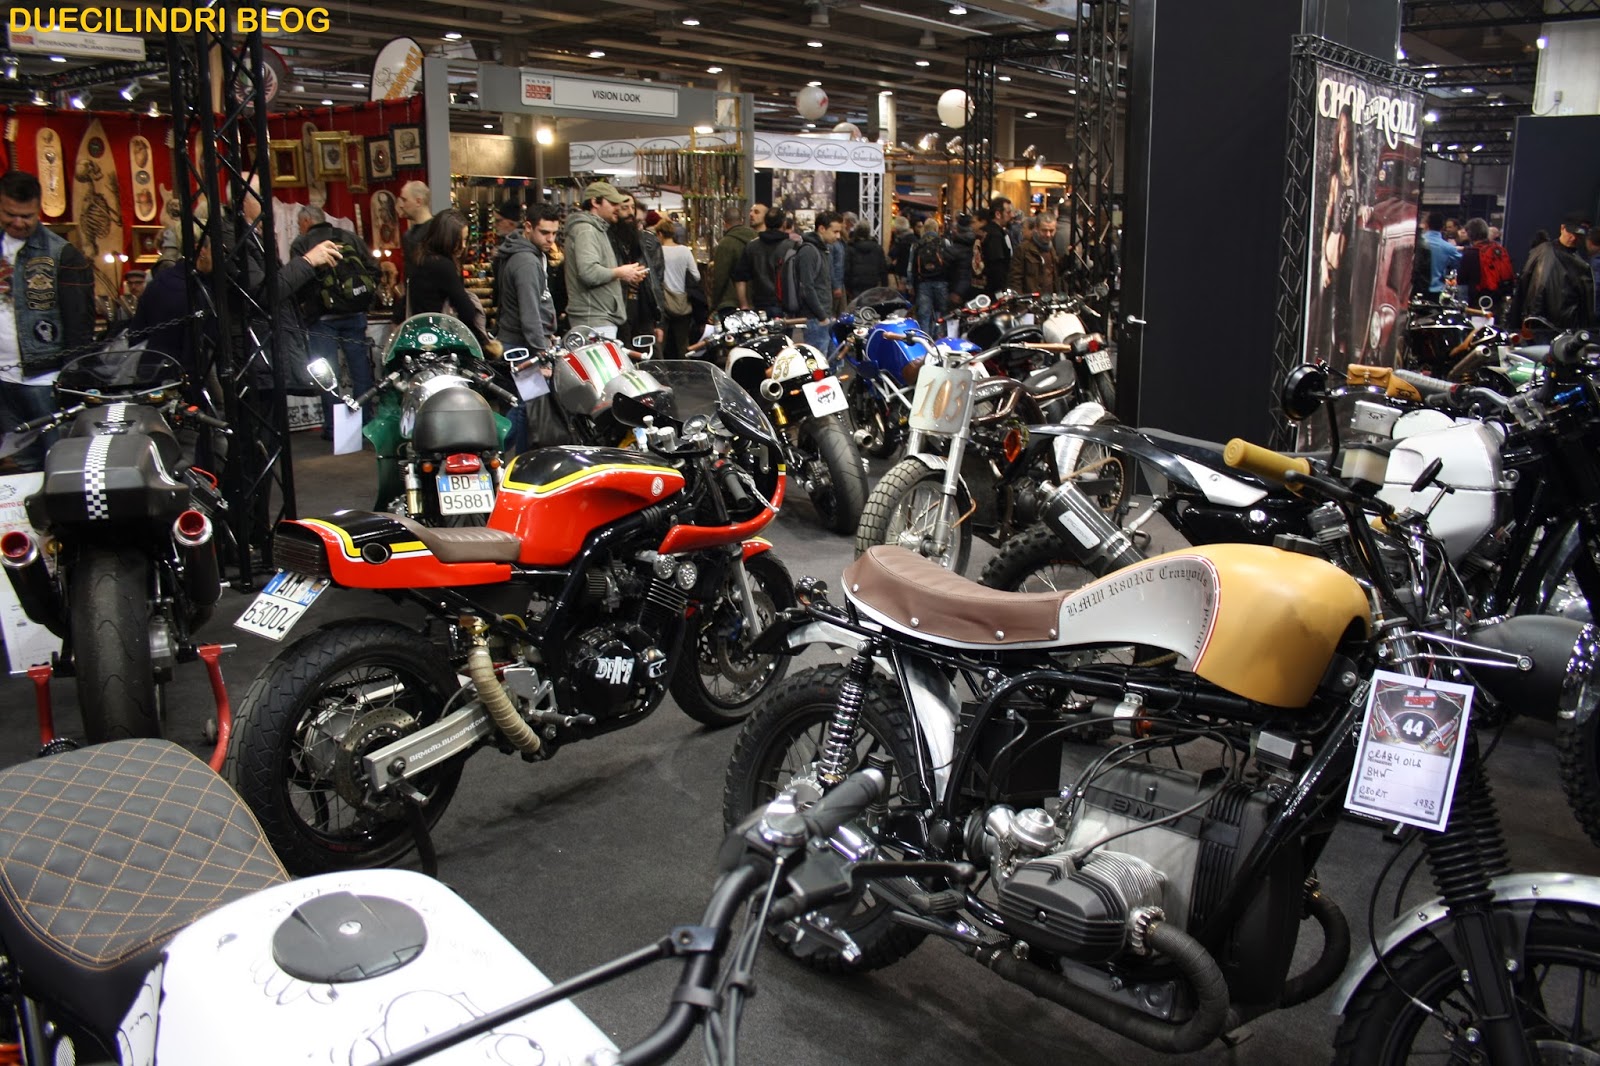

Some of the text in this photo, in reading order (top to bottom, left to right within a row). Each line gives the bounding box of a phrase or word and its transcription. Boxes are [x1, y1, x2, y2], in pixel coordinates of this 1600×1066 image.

[592, 90, 641, 103] VISION LOOK
[1318, 77, 1366, 125] CHOP
[1376, 95, 1417, 150] ROLL
[913, 378, 968, 423] 103
[451, 475, 471, 490] BD
[443, 493, 492, 510] 95881
[1065, 589, 1105, 618] BMW
[1108, 568, 1155, 598] R80RT
[243, 599, 300, 634] 63004
[1402, 718, 1424, 737] 44
